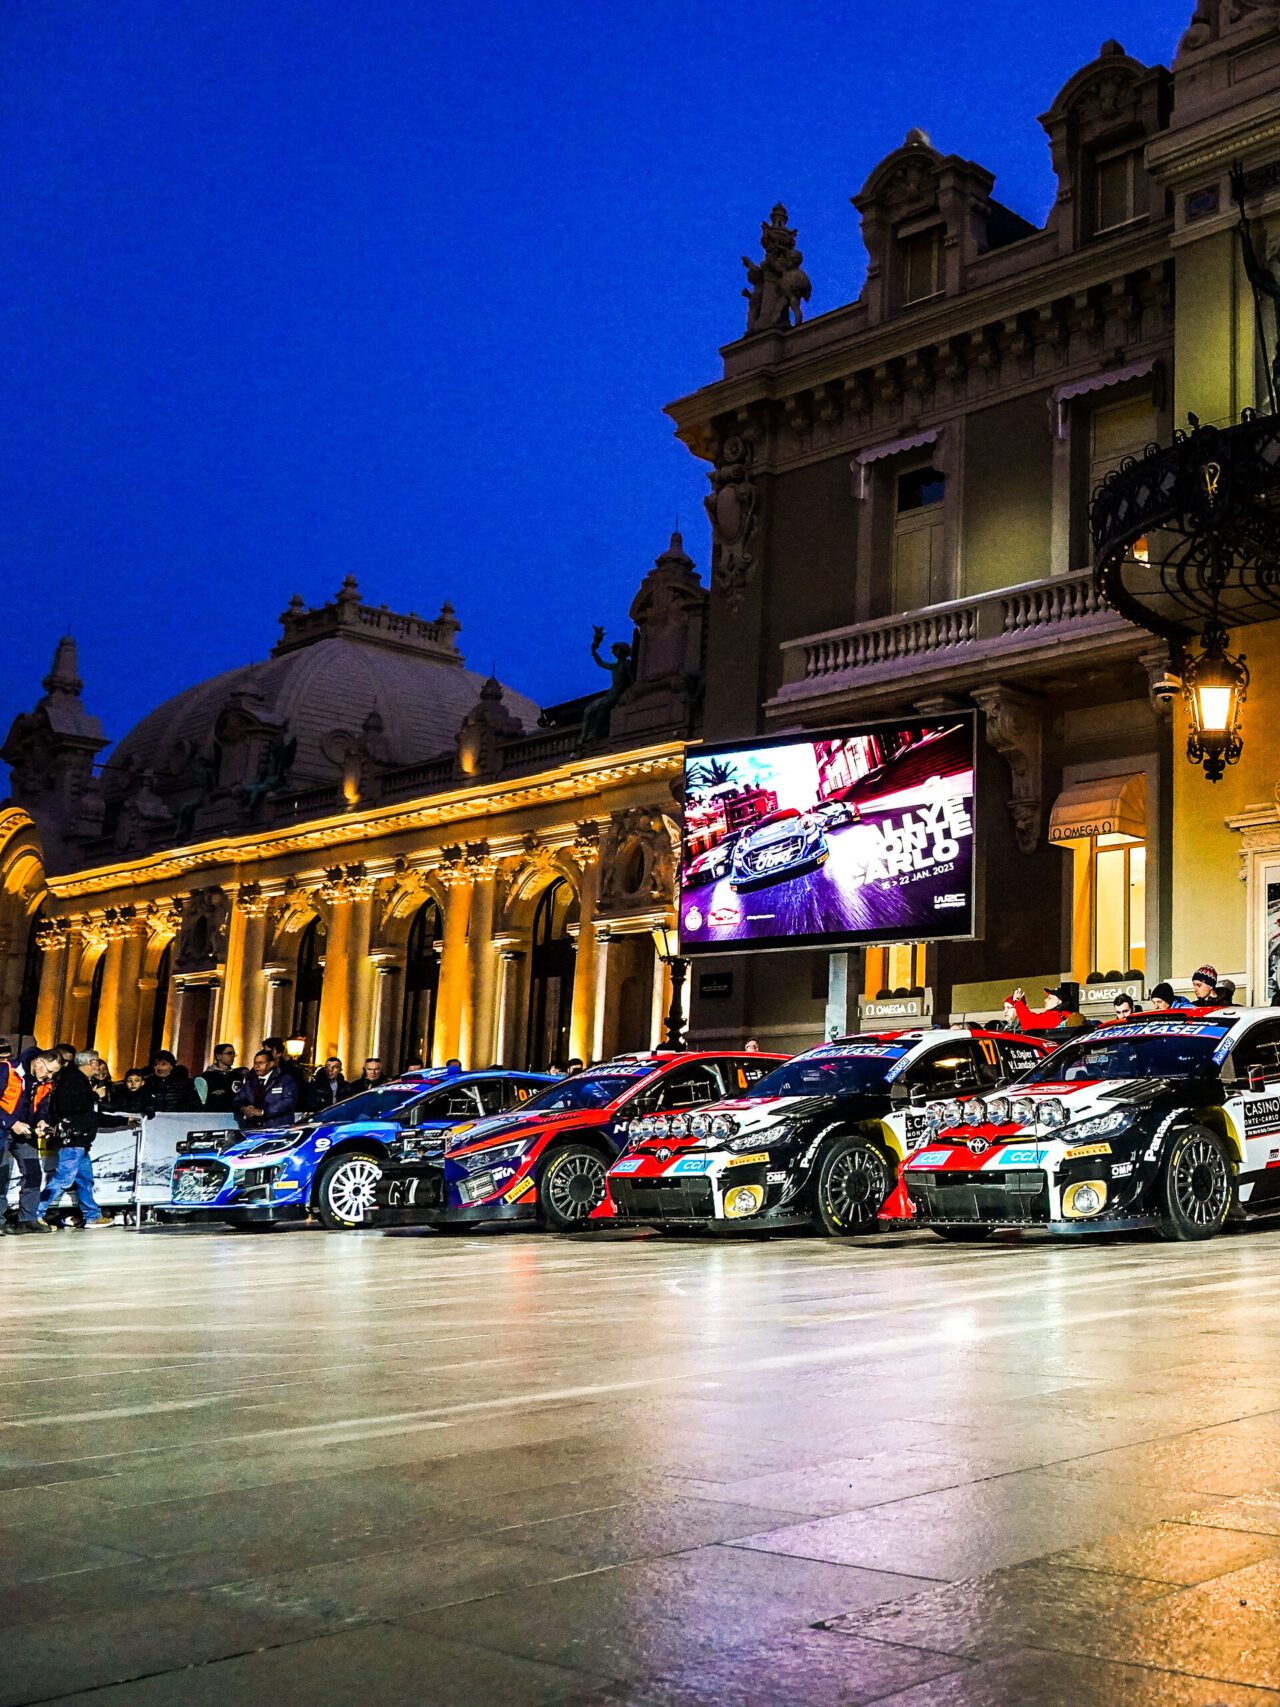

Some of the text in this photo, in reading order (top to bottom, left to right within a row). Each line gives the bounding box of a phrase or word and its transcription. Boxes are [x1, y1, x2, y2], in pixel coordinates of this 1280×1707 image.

[1064, 824, 1099, 837] OMEGA
[899, 875, 910, 885] 22
[933, 862, 954, 875] 2023
[1087, 987, 1123, 1000] OMEGA
[876, 1004, 906, 1015] OMEGA
[979, 1040, 997, 1065] 17
[1245, 1099, 1280, 1116] CASINO
[1244, 1113, 1279, 1126] ONTE-CARLO
